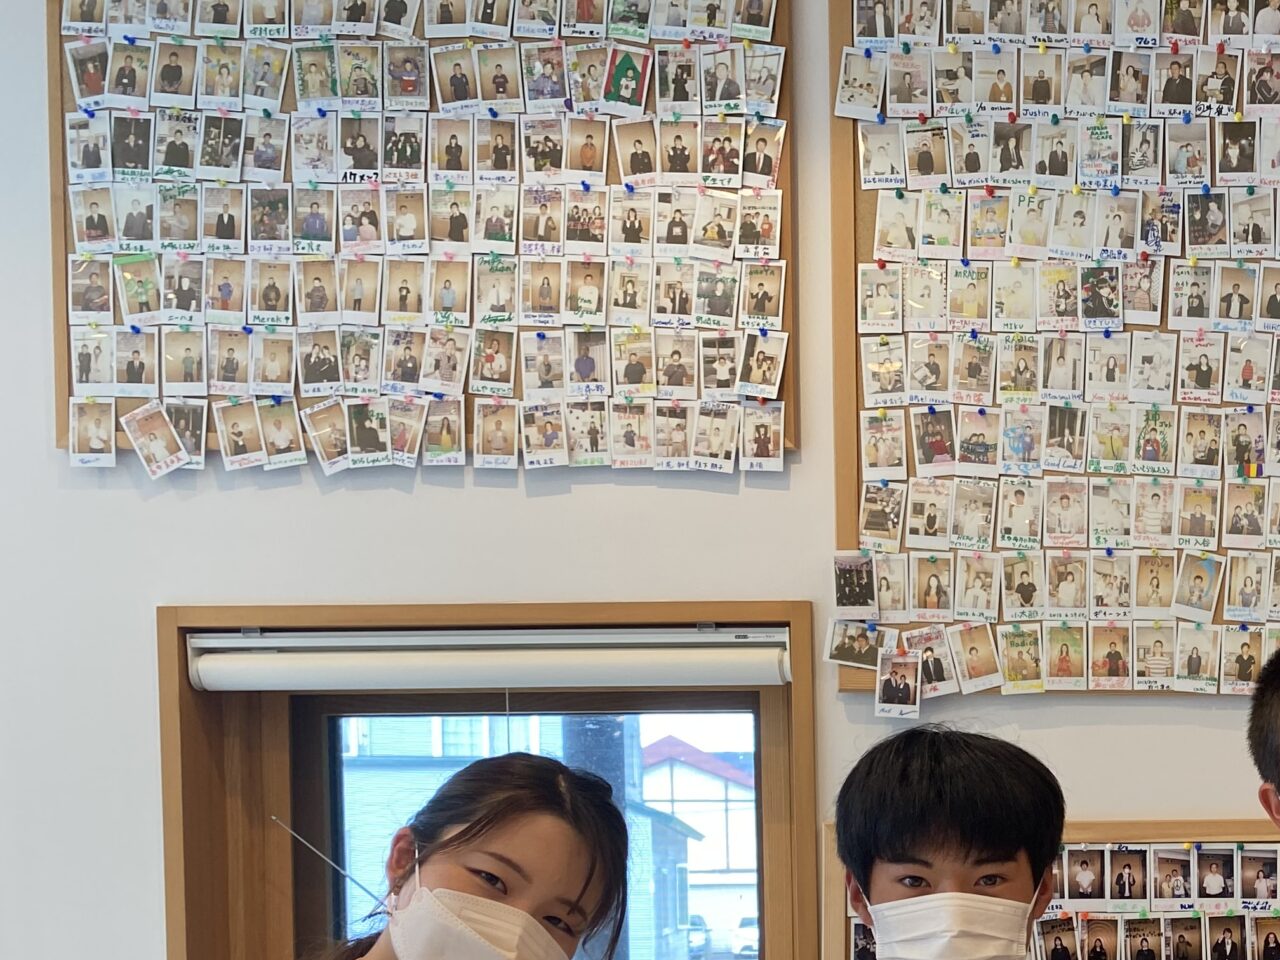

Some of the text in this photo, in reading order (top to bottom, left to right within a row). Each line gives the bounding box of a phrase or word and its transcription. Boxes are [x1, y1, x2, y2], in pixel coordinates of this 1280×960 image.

[1022, 108, 1049, 117] Justin
[1002, 322, 1025, 330] MIKU
[1004, 336, 1035, 344] RADIO
[1178, 537, 1191, 546] DH
